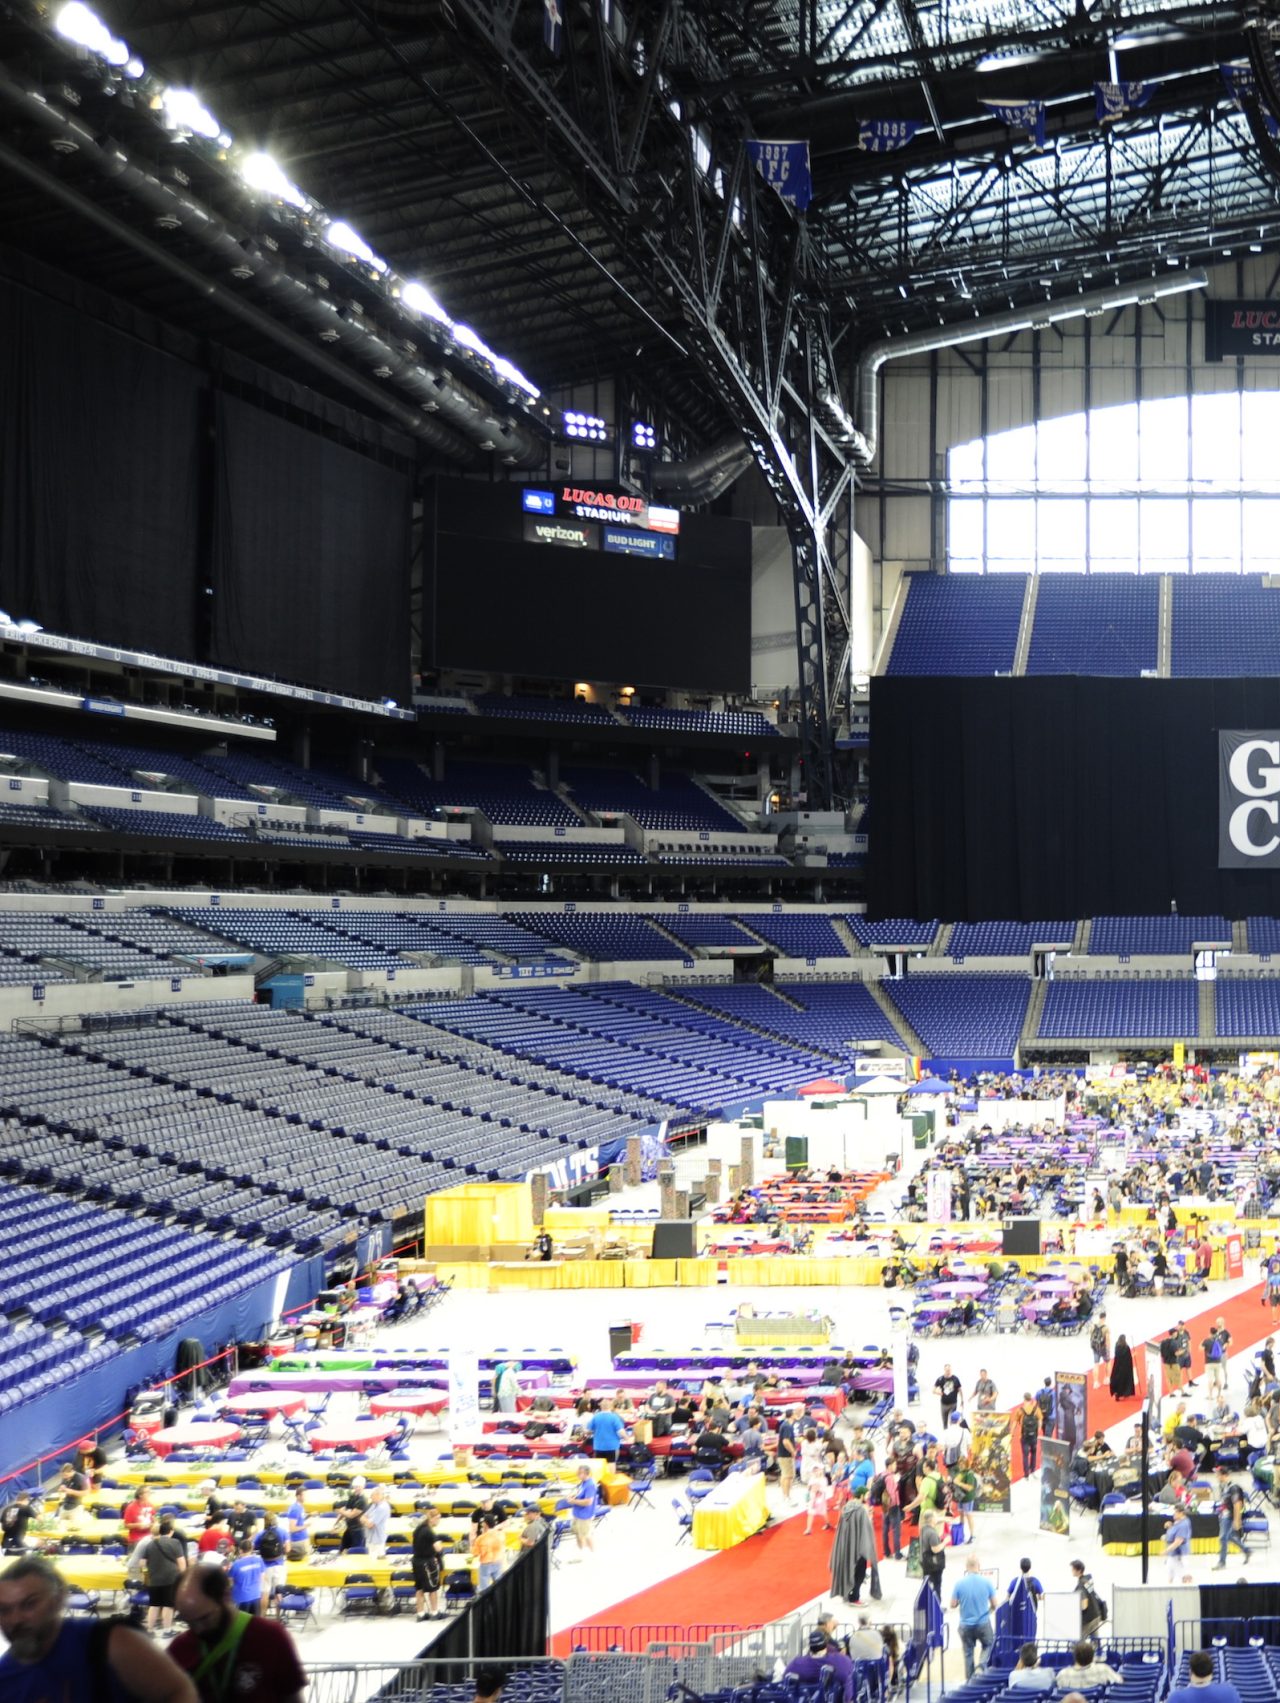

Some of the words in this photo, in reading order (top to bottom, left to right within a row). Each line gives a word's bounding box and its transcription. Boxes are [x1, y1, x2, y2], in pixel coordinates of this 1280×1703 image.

[759, 145, 788, 160] 1987
[562, 487, 614, 507] LUCAS
[617, 496, 643, 511] OIL
[576, 505, 631, 523] STADIUM
[535, 525, 584, 541] verizon
[607, 535, 628, 545] BUD
[628, 536, 656, 549] LIGHT
[26, 633, 68, 649] DICKERSON
